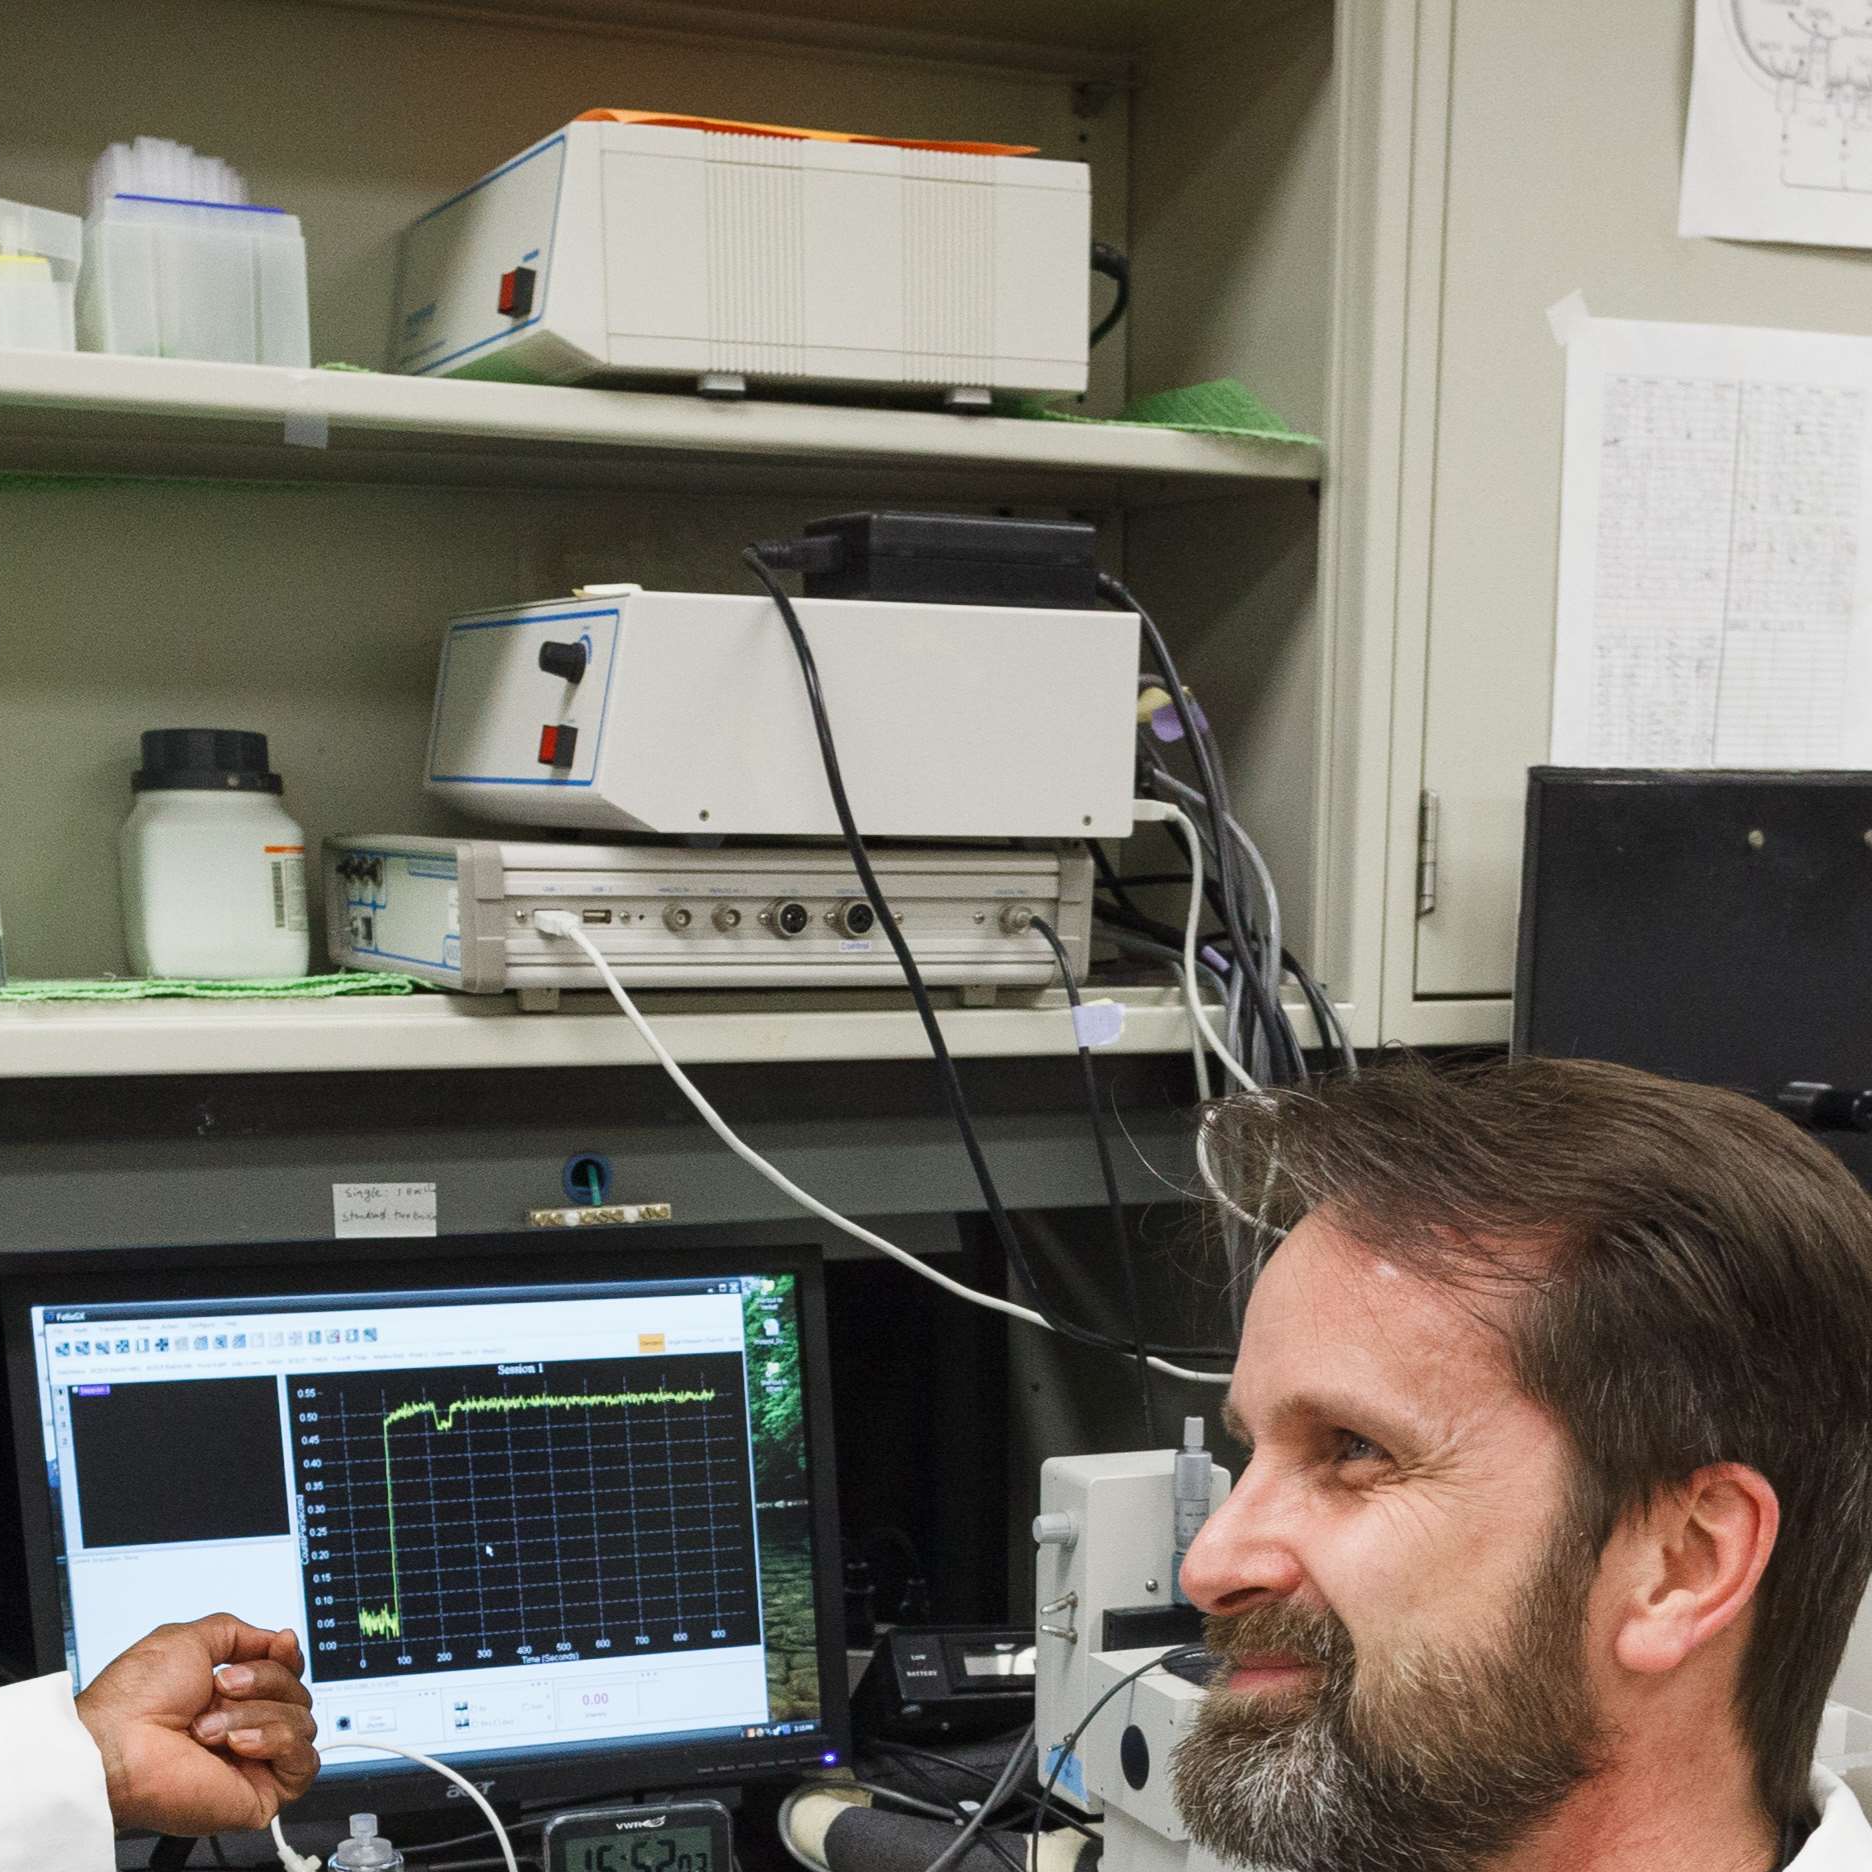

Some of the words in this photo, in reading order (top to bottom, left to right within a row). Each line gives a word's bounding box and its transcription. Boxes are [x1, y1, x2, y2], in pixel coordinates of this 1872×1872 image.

[497, 1364, 536, 1376] Session
[297, 1389, 316, 1398] 0.55
[299, 1413, 318, 1422] 0.50
[301, 1436, 320, 1445] 0.45
[303, 1459, 322, 1468] 0.40
[305, 1482, 324, 1491] 0.35
[307, 1505, 326, 1514] 0.30
[309, 1527, 328, 1537] 0.25
[311, 1550, 329, 1560] 0.20
[313, 1573, 331, 1583] 0.15
[315, 1596, 333, 1605] 0.10
[317, 1619, 335, 1628] 0.05
[319, 1641, 337, 1650] 0.00
[397, 1656, 412, 1666] 100
[437, 1652, 452, 1662] 200
[477, 1649, 493, 1659] 300
[556, 1642, 571, 1652] 500
[595, 1639, 611, 1649] 600
[635, 1635, 650, 1645] 700
[673, 1632, 688, 1642] 800
[711, 1629, 726, 1639] 900
[522, 1655, 540, 1665] Time
[542, 1651, 580, 1664] (Seconds)
[582, 1693, 608, 1706] 0.00
